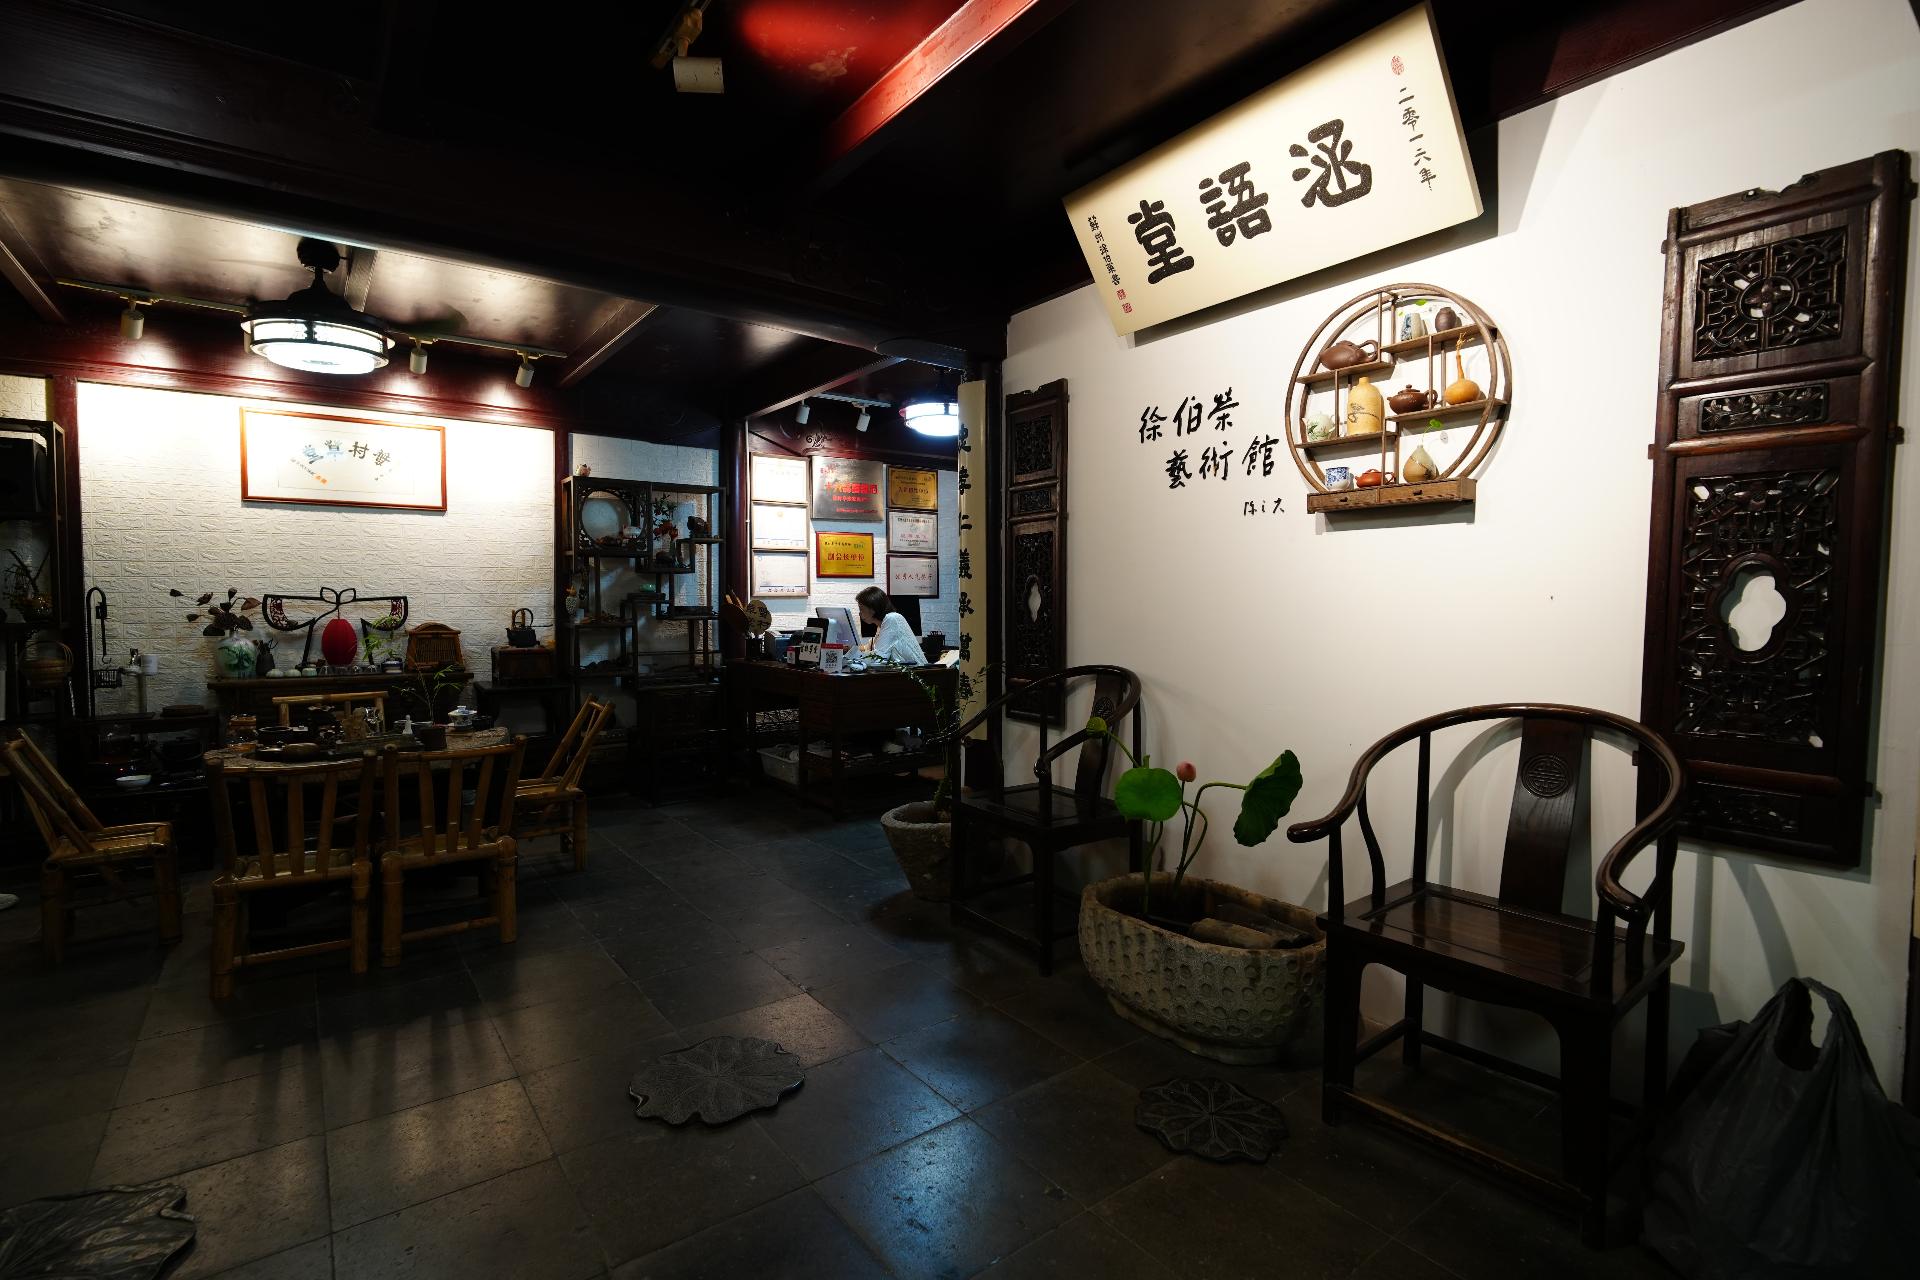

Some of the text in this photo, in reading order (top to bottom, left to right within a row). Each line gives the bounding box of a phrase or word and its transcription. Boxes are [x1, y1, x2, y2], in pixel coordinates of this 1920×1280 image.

[1398, 87, 1436, 191] 二零一六年
